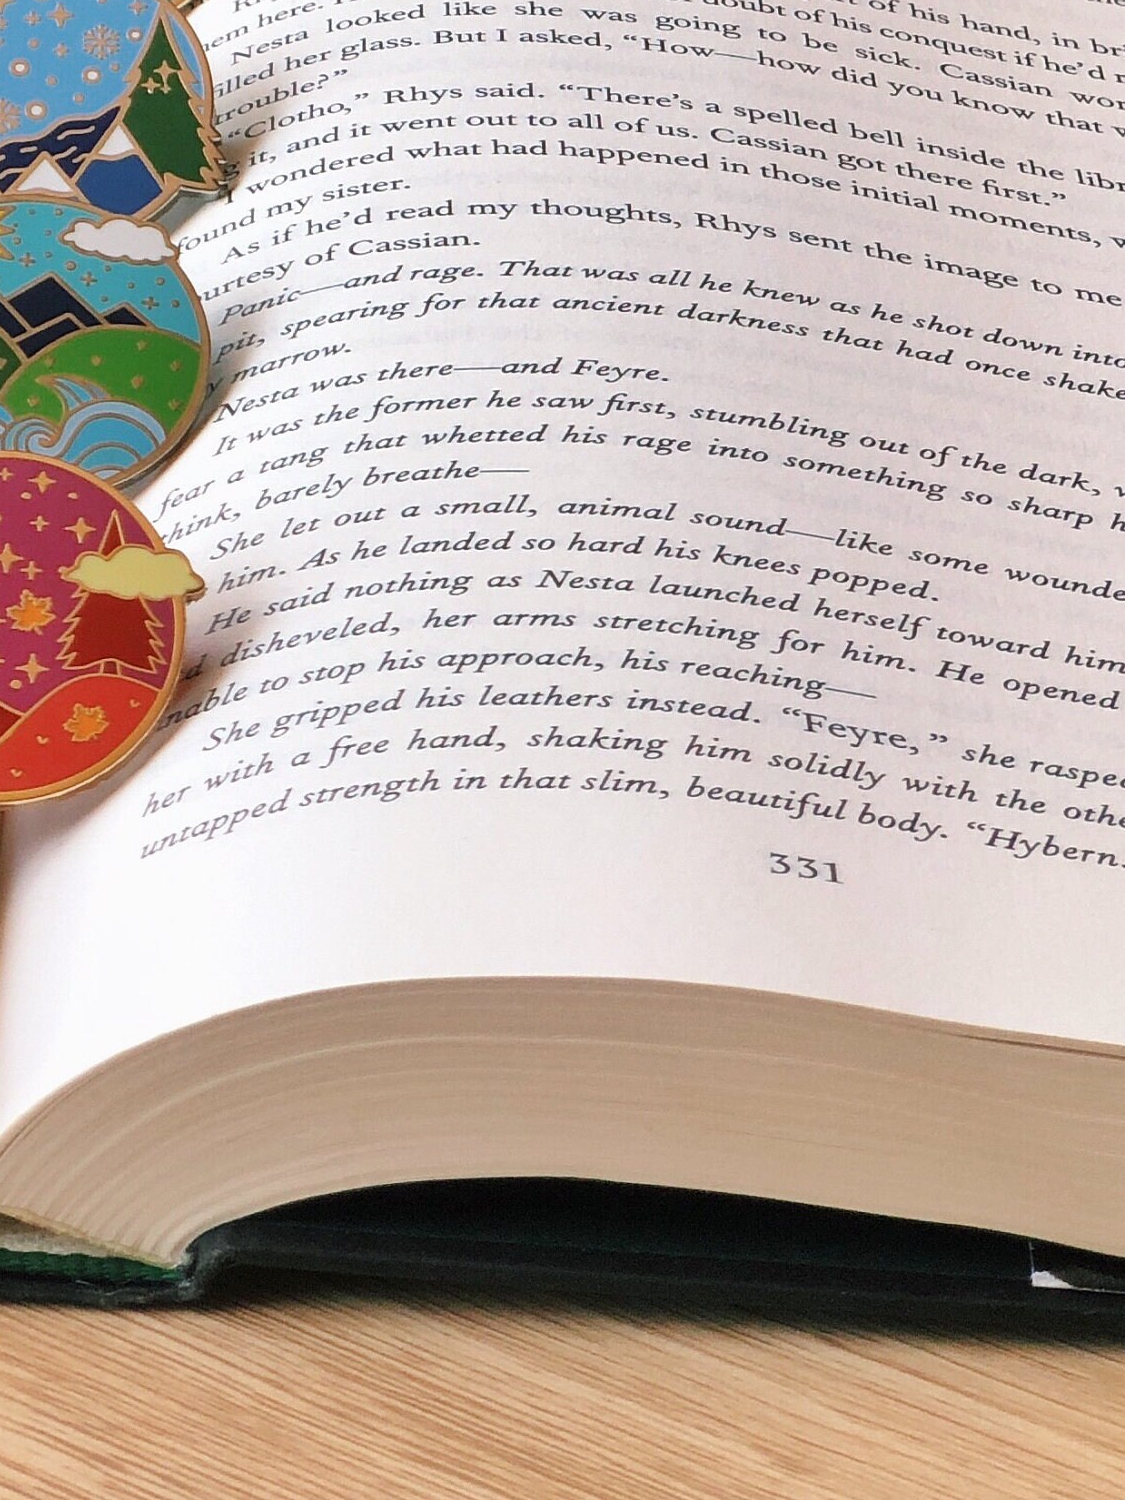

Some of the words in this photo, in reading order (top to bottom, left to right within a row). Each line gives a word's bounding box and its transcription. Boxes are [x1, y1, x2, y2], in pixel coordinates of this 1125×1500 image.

[231, 30, 309, 65] Nesta
[325, 3, 426, 34] looked
[442, 1, 497, 17] like
[514, 0, 564, 17] she
[580, 8, 638, 23] was
[655, 15, 742, 40] going
[757, 27, 787, 43] to
[801, 32, 838, 53] be
[855, 46, 921, 71] sick.
[939, 63, 1054, 98] Cassian
[245, 146, 394, 194] wondered
[404, 140, 483, 160] what
[490, 138, 548, 156] had
[557, 139, 710, 170] happened
[719, 151, 751, 176] in
[759, 162, 842, 192] those
[850, 179, 940, 213] initial
[947, 204, 1102, 249] moments,
[279, 300, 410, 340] spearing
[413, 292, 467, 318] for
[477, 291, 541, 309] that
[552, 298, 666, 316] ancient
[676, 302, 810, 337] darkness
[822, 326, 884, 351] that
[895, 339, 955, 366] had
[965, 359, 1032, 382] once
[154, 479, 216, 523] fear
[226, 469, 245, 485] a
[258, 446, 330, 475] tang
[342, 432, 409, 455] that
[421, 423, 550, 446] whetted
[560, 424, 608, 445] his
[622, 434, 692, 456] rage
[708, 440, 769, 463] into
[782, 456, 948, 502] something
[960, 490, 993, 506] so
[1006, 495, 1094, 531] sharp
[204, 606, 252, 636] He
[262, 581, 336, 617] said
[343, 571, 474, 600] nothing
[486, 575, 523, 588] as
[534, 569, 636, 592] Nesta
[648, 574, 802, 613] launched
[813, 597, 932, 641] herself
[936, 626, 1051, 660] toward
[140, 787, 293, 860] untapped
[298, 768, 442, 807] strength
[452, 769, 488, 791] in
[499, 766, 572, 790] that
[579, 768, 670, 800] slim,
[686, 775, 849, 821] beautiful
[857, 802, 948, 843] body.
[769, 851, 844, 885] 331
